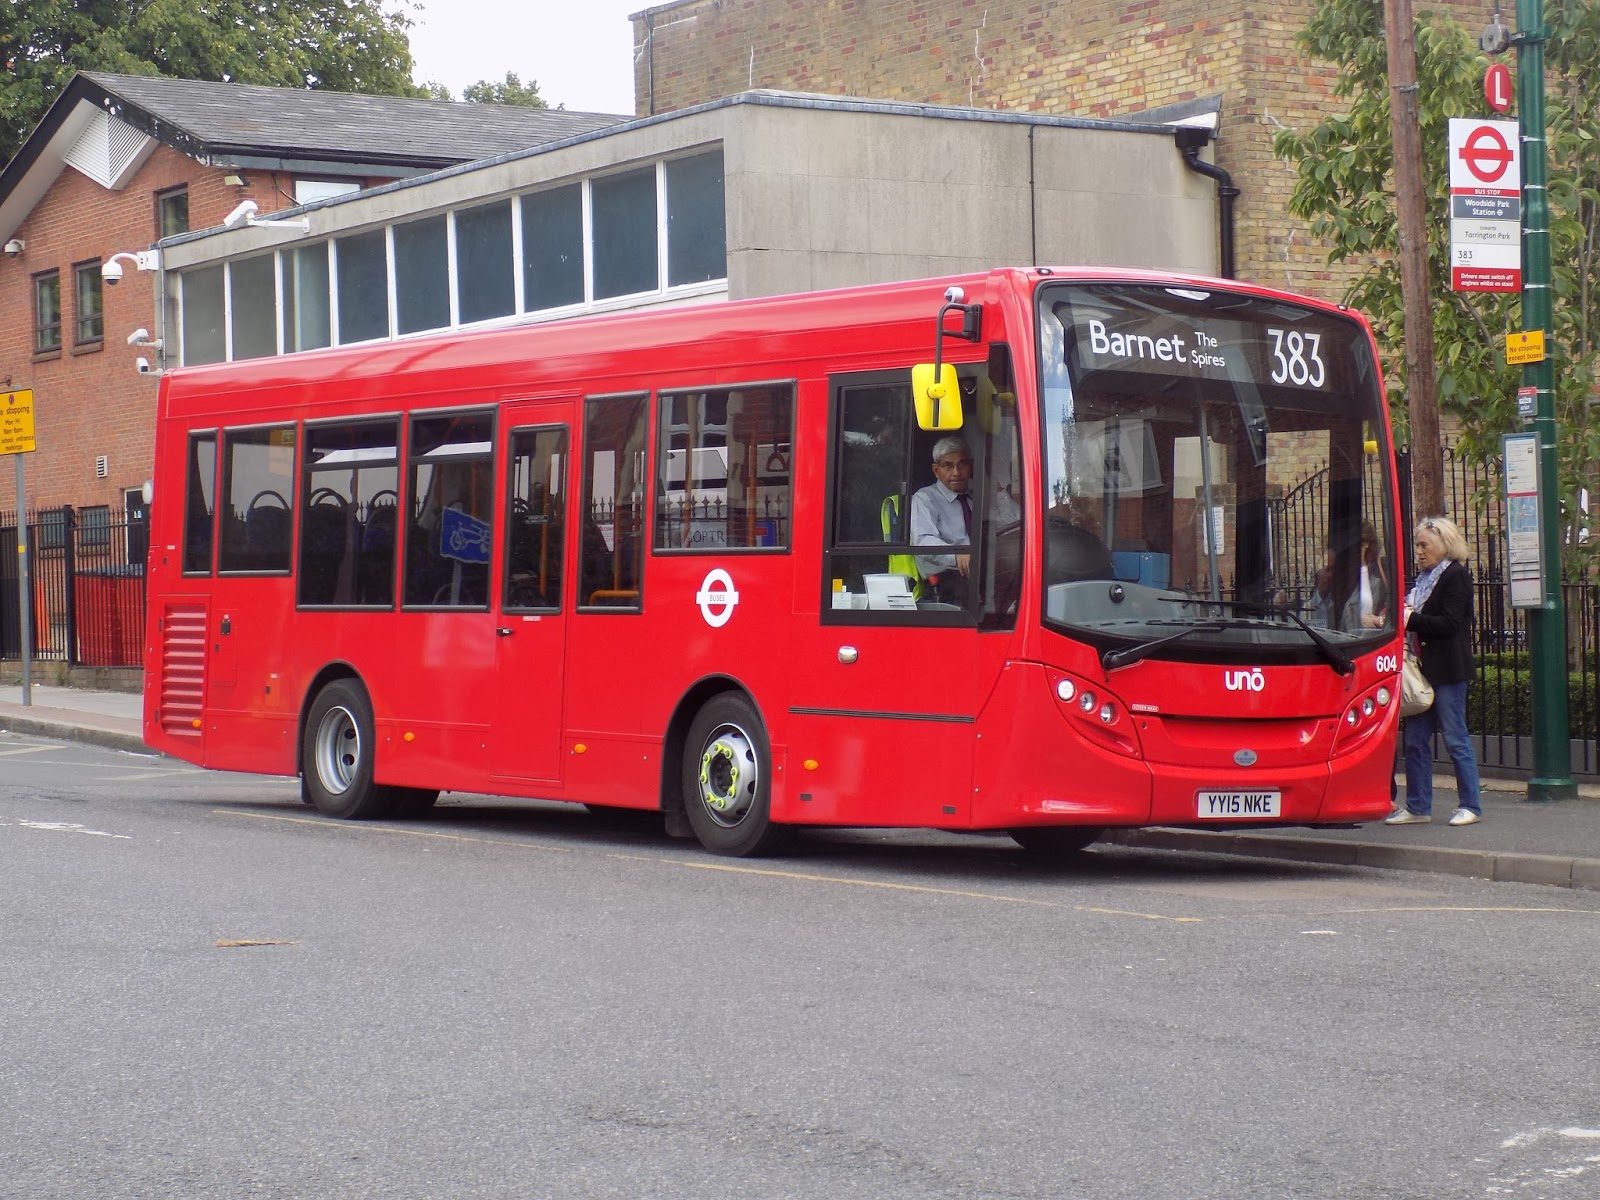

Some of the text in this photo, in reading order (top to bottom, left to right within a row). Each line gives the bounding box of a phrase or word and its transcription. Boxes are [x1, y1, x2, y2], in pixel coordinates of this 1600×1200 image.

[1495, 71, 1507, 106] L
[1465, 199, 1510, 208] Woodside Park
[1472, 208, 1496, 216] Station
[1465, 231, 1511, 241] Torrington Park
[1457, 250, 1473, 260] 383
[1089, 319, 1218, 363] Barnet The
[1518, 344, 1541, 352] stopping
[1191, 349, 1226, 368] Spires
[1267, 328, 1325, 388] 383
[6, 406, 29, 414] stopping
[709, 594, 725, 602] BUSES
[1376, 655, 1398, 673] 604
[1208, 794, 1273, 813] YY15 NKE
